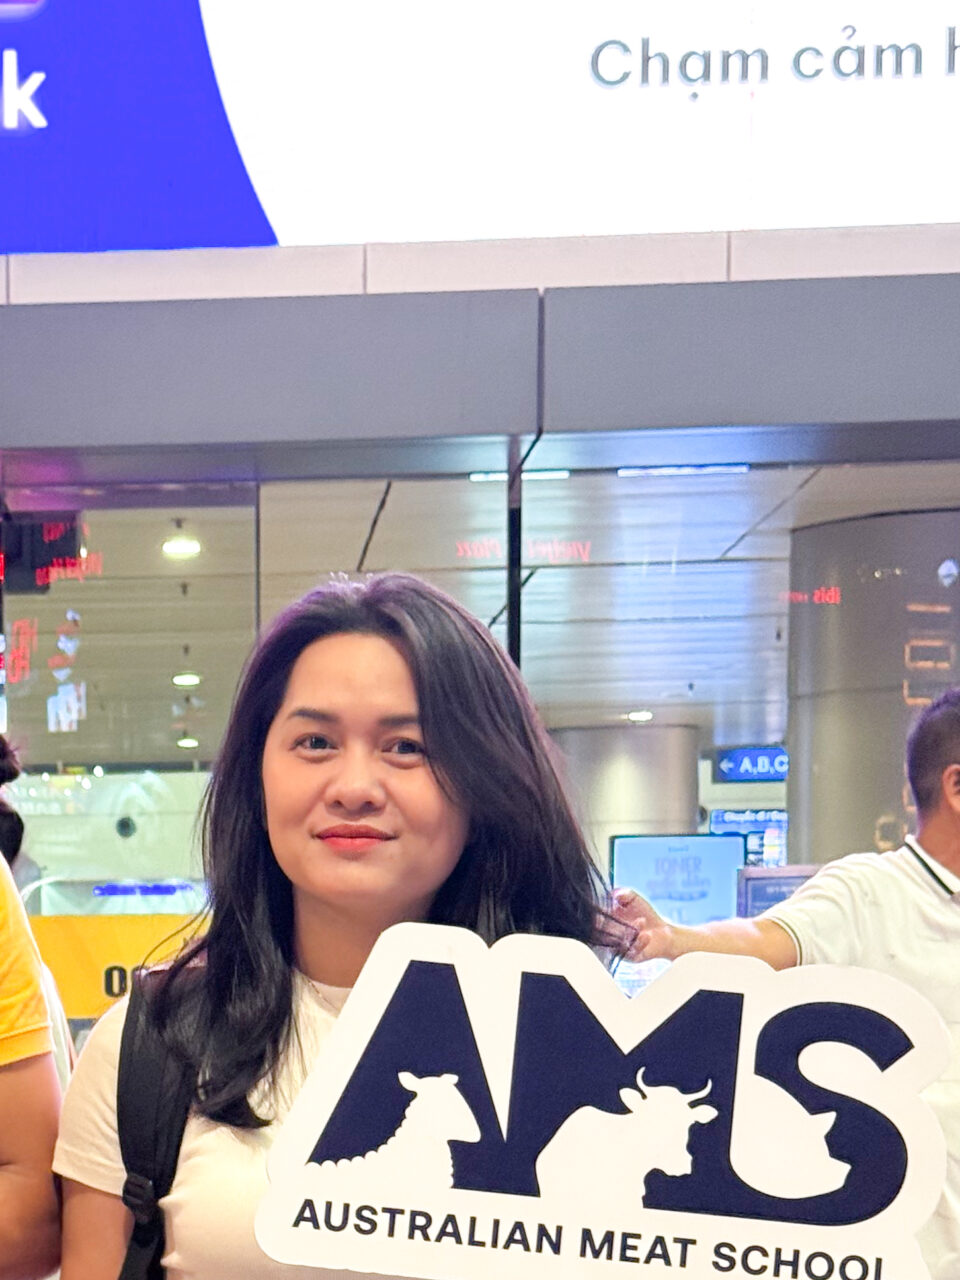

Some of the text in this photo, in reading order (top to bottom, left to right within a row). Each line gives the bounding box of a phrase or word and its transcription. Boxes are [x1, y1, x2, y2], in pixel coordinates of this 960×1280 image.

[590, 36, 769, 102] Chạm
[791, 25, 924, 80] cảm
[306, 959, 915, 1226] AMS
[292, 1198, 563, 1256] AUSTRALIAN
[579, 1228, 697, 1269] MEAT
